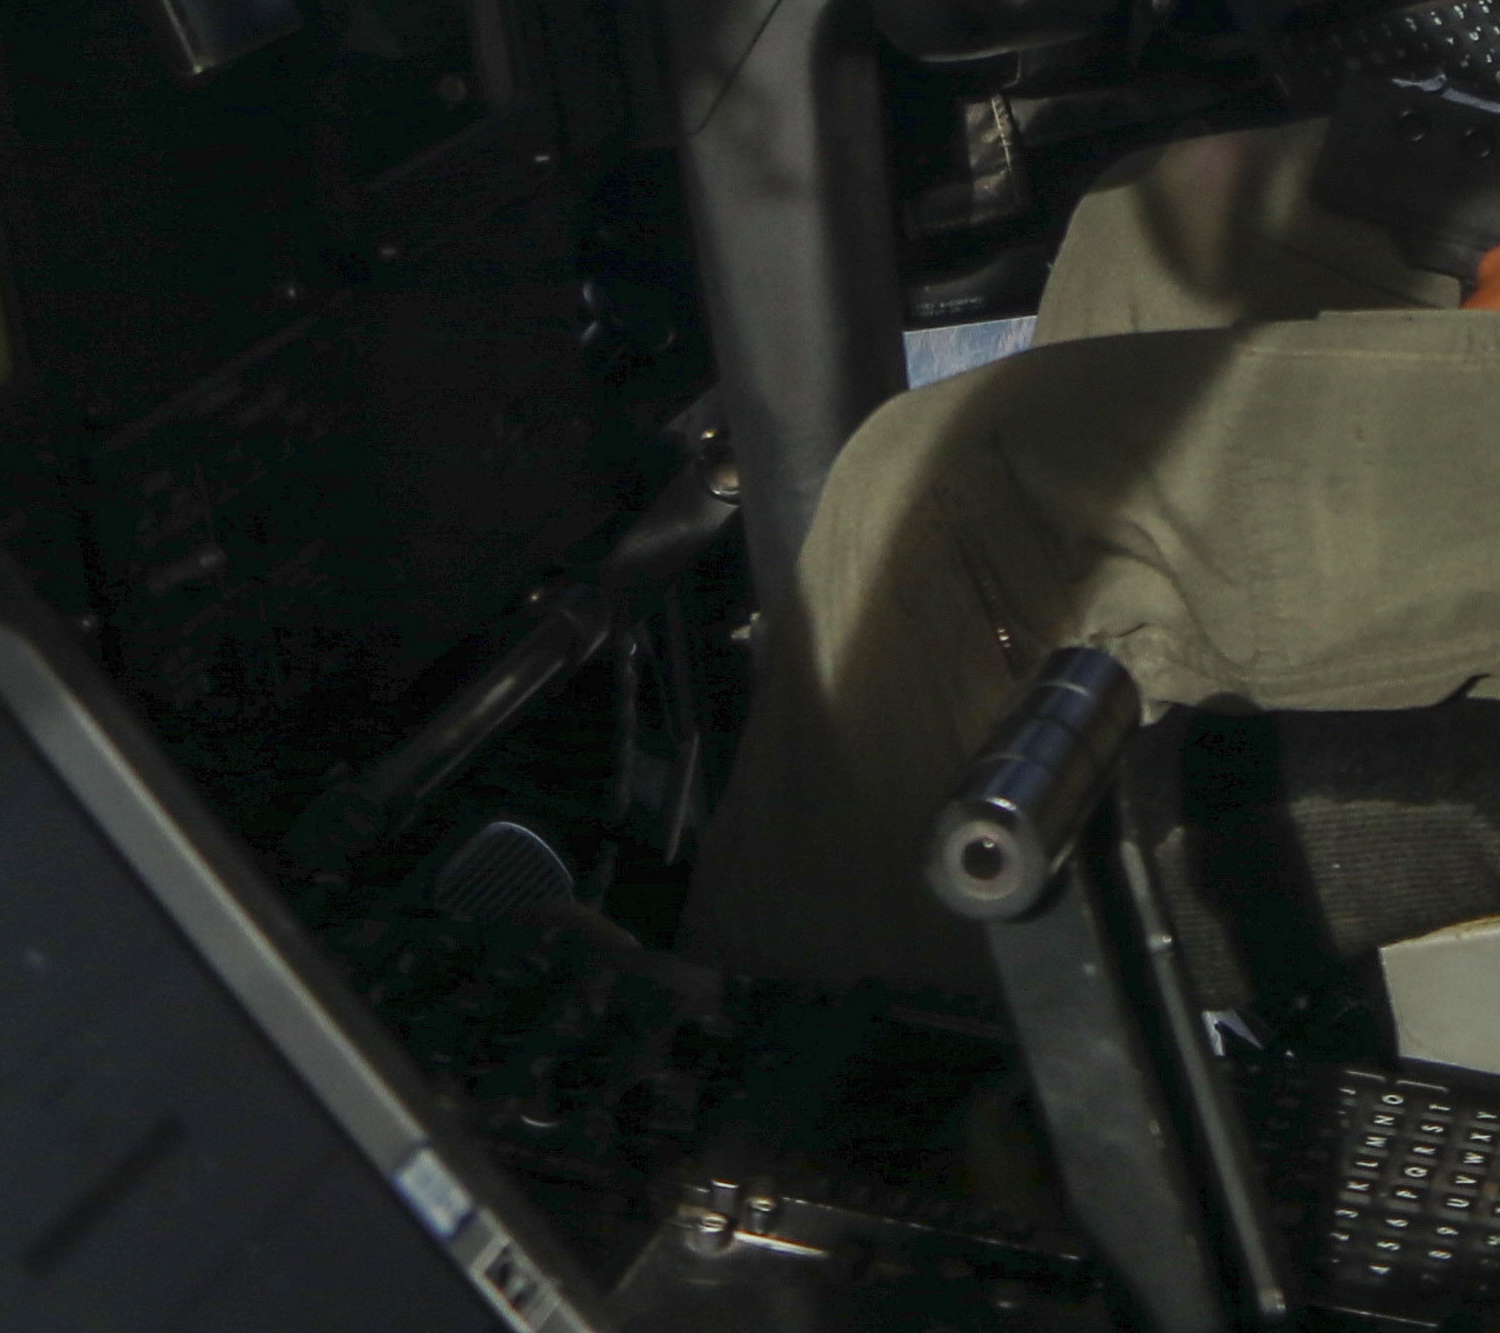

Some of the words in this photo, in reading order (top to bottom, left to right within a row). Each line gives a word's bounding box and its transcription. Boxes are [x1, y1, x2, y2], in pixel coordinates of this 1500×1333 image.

[1382, 1094, 1404, 1105] O
[1374, 1114, 1395, 1126] N
[1476, 1111, 1498, 1120] Y
[1421, 1124, 1444, 1134] S
[1365, 1136, 1387, 1148] M
[1471, 1132, 1492, 1143] X
[1464, 1152, 1484, 1164] W
[1456, 1175, 1477, 1184] V
[1447, 1198, 1470, 1208] U
